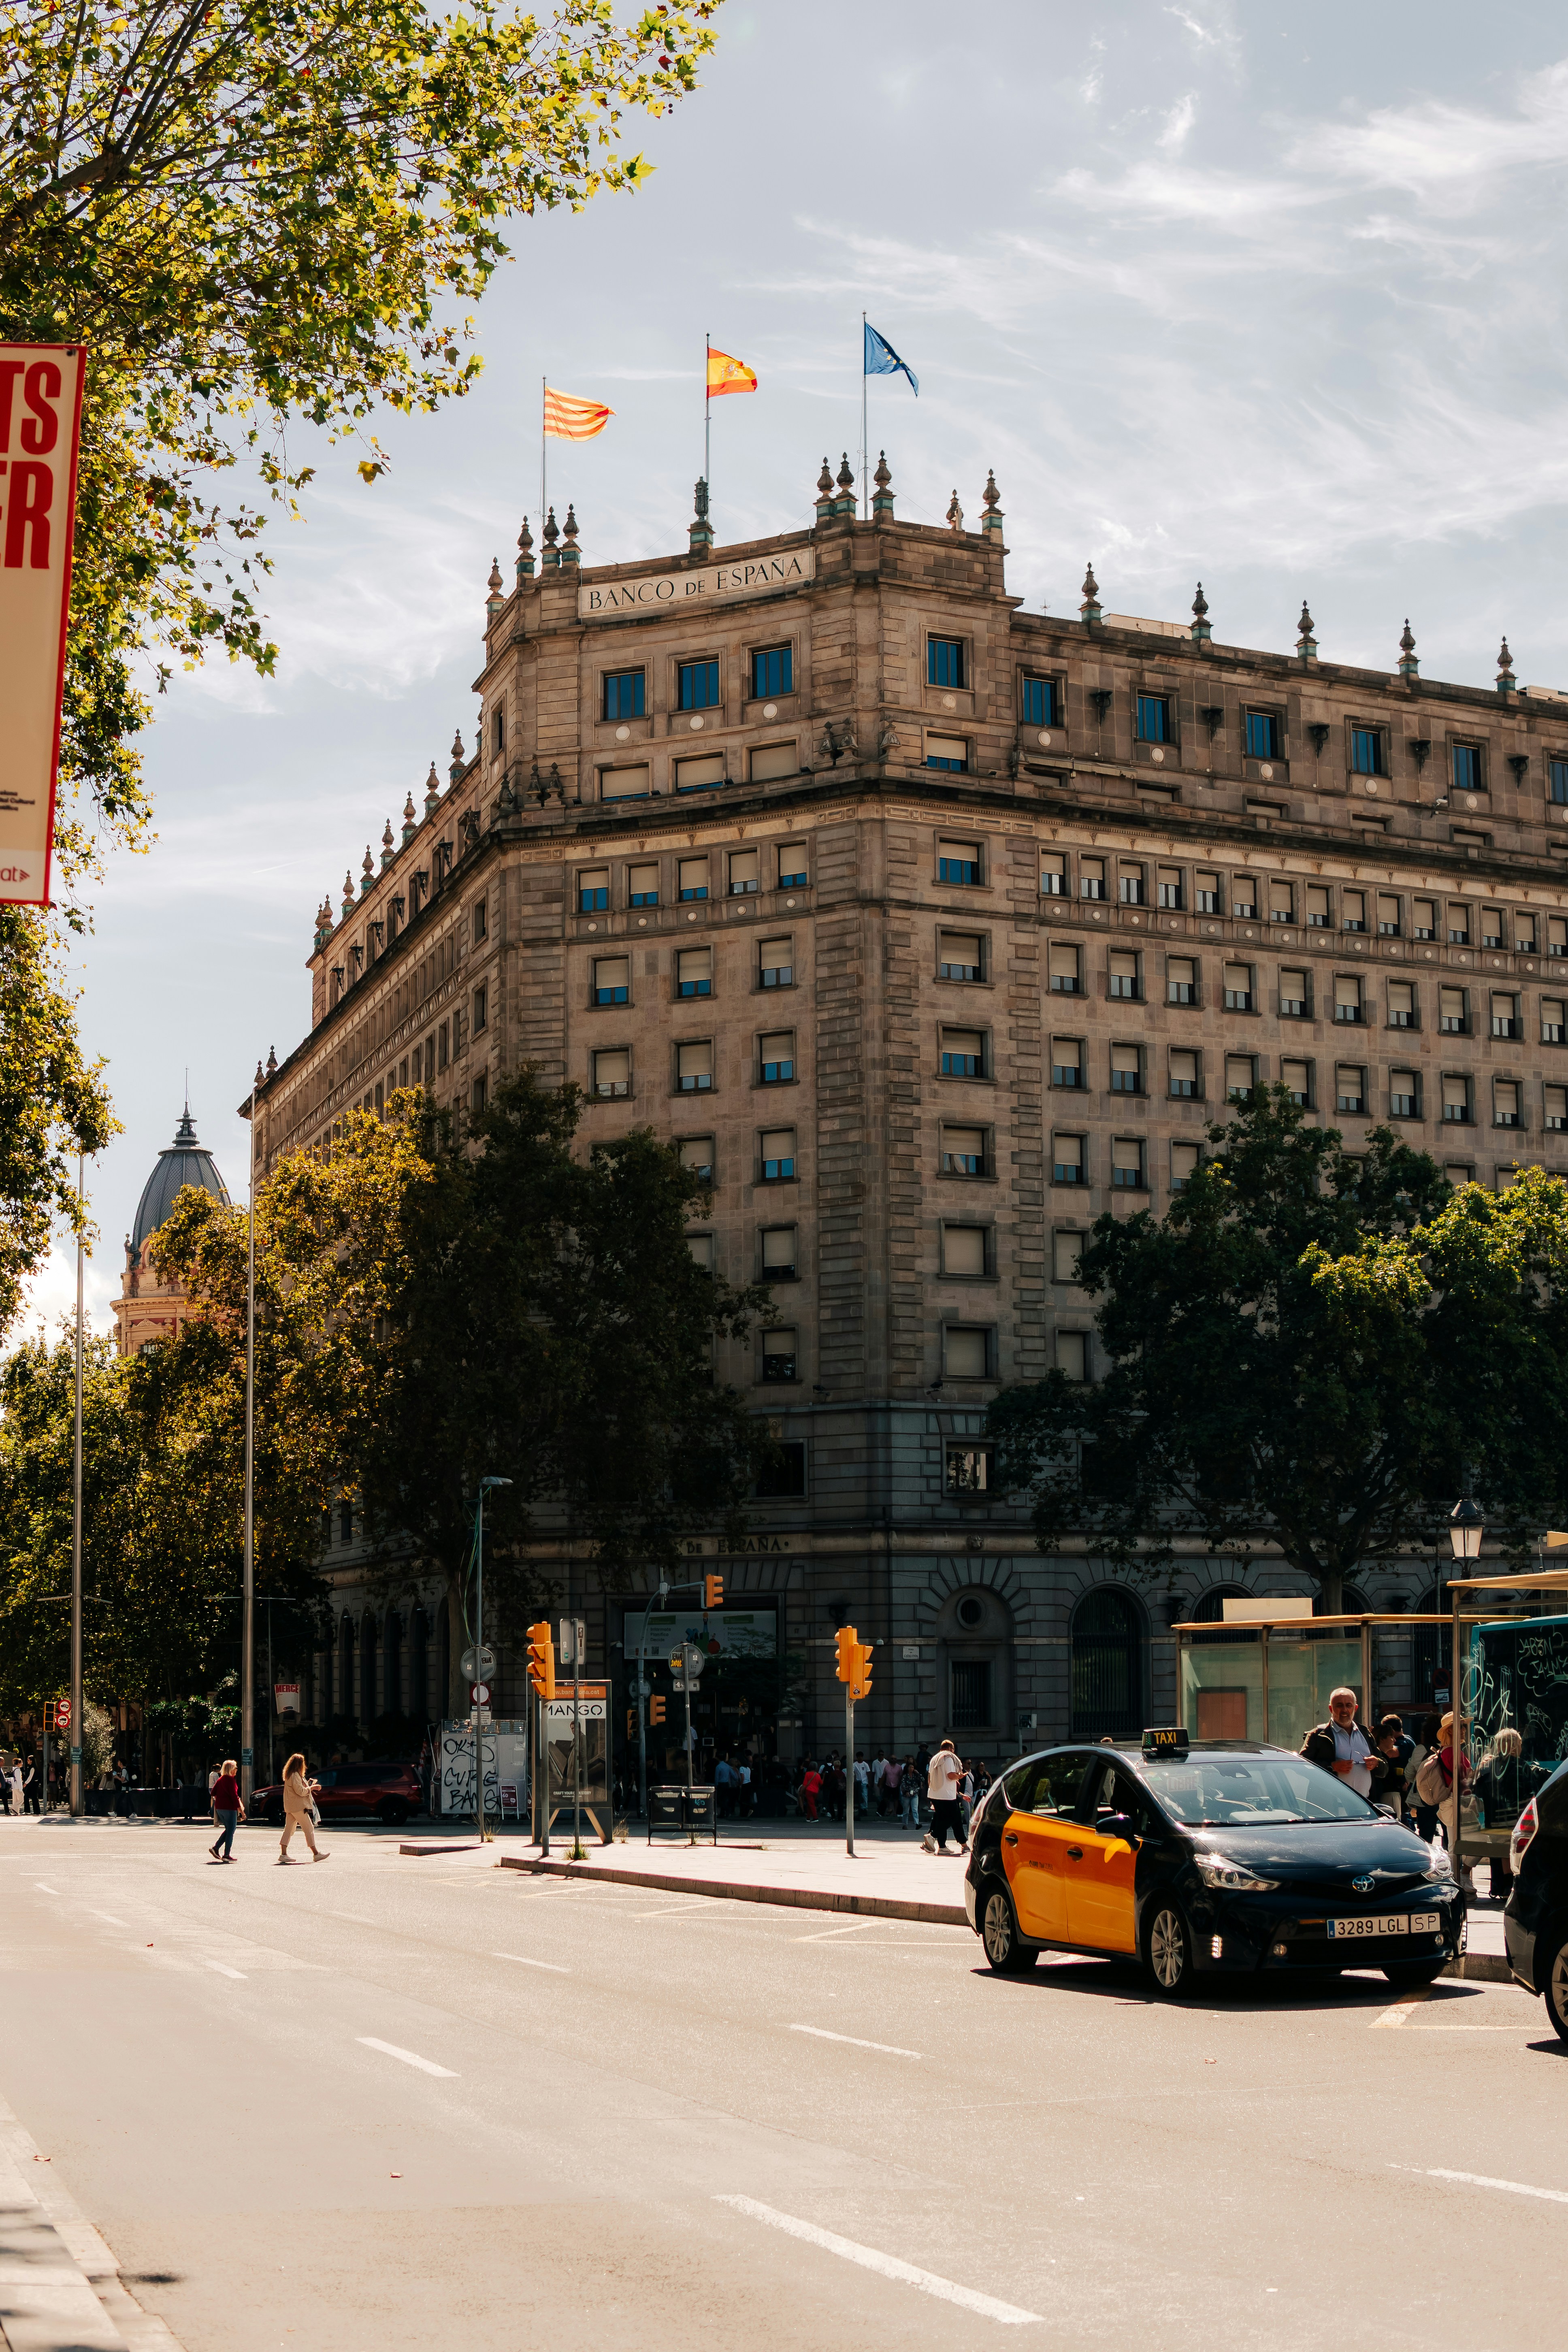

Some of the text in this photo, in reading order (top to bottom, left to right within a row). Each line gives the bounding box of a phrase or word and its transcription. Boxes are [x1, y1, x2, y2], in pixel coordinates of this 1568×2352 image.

[0, 460, 53, 569] R
[590, 557, 802, 609] BANCO DE ESPAÑA
[688, 1542, 702, 1553] DE
[1154, 1732, 1176, 1744] TAXI
[1168, 1777, 1197, 1791] LIBRE
[1338, 1920, 1373, 1935] 3289
[1378, 1918, 1404, 1933] LGL
